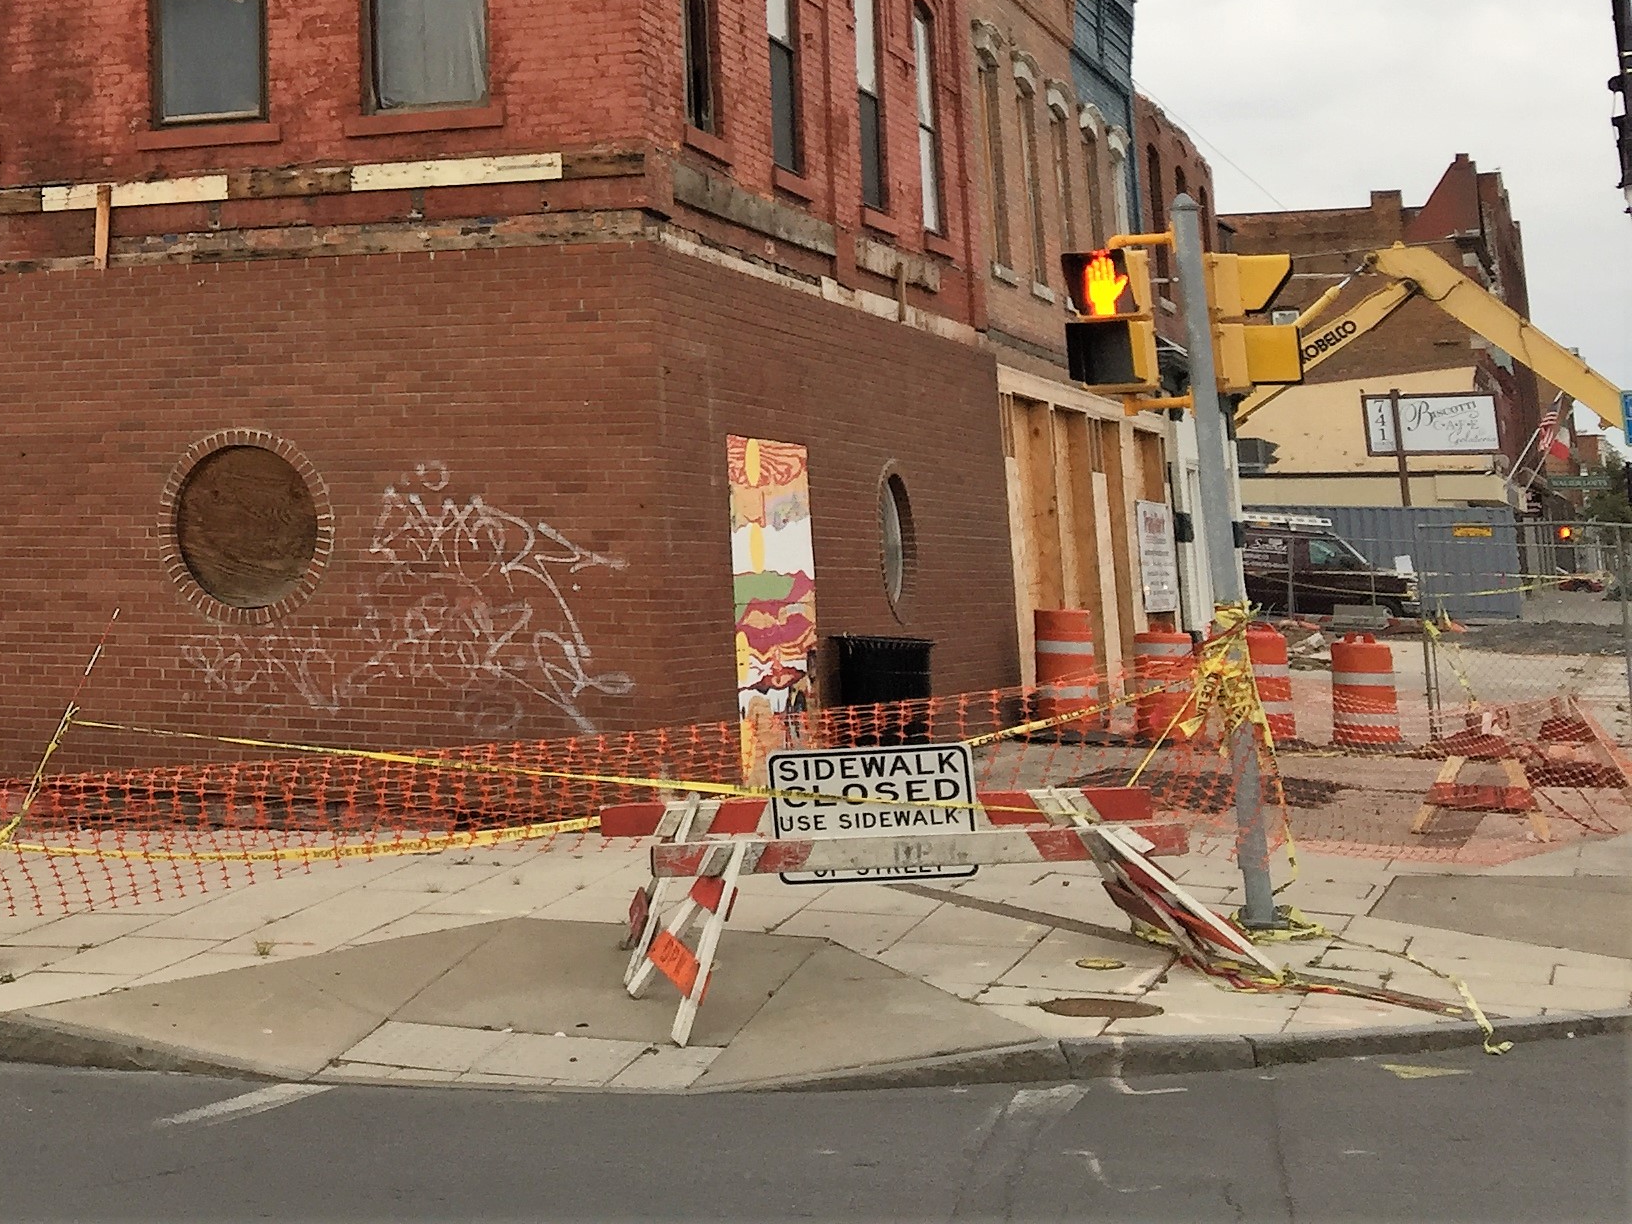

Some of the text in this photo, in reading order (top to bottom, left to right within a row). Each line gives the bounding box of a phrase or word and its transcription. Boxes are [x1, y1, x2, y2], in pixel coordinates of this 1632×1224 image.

[779, 751, 959, 782] SIDEWALK
[782, 778, 961, 808] CLOSED
[780, 808, 960, 832] USE SIDEWALK
